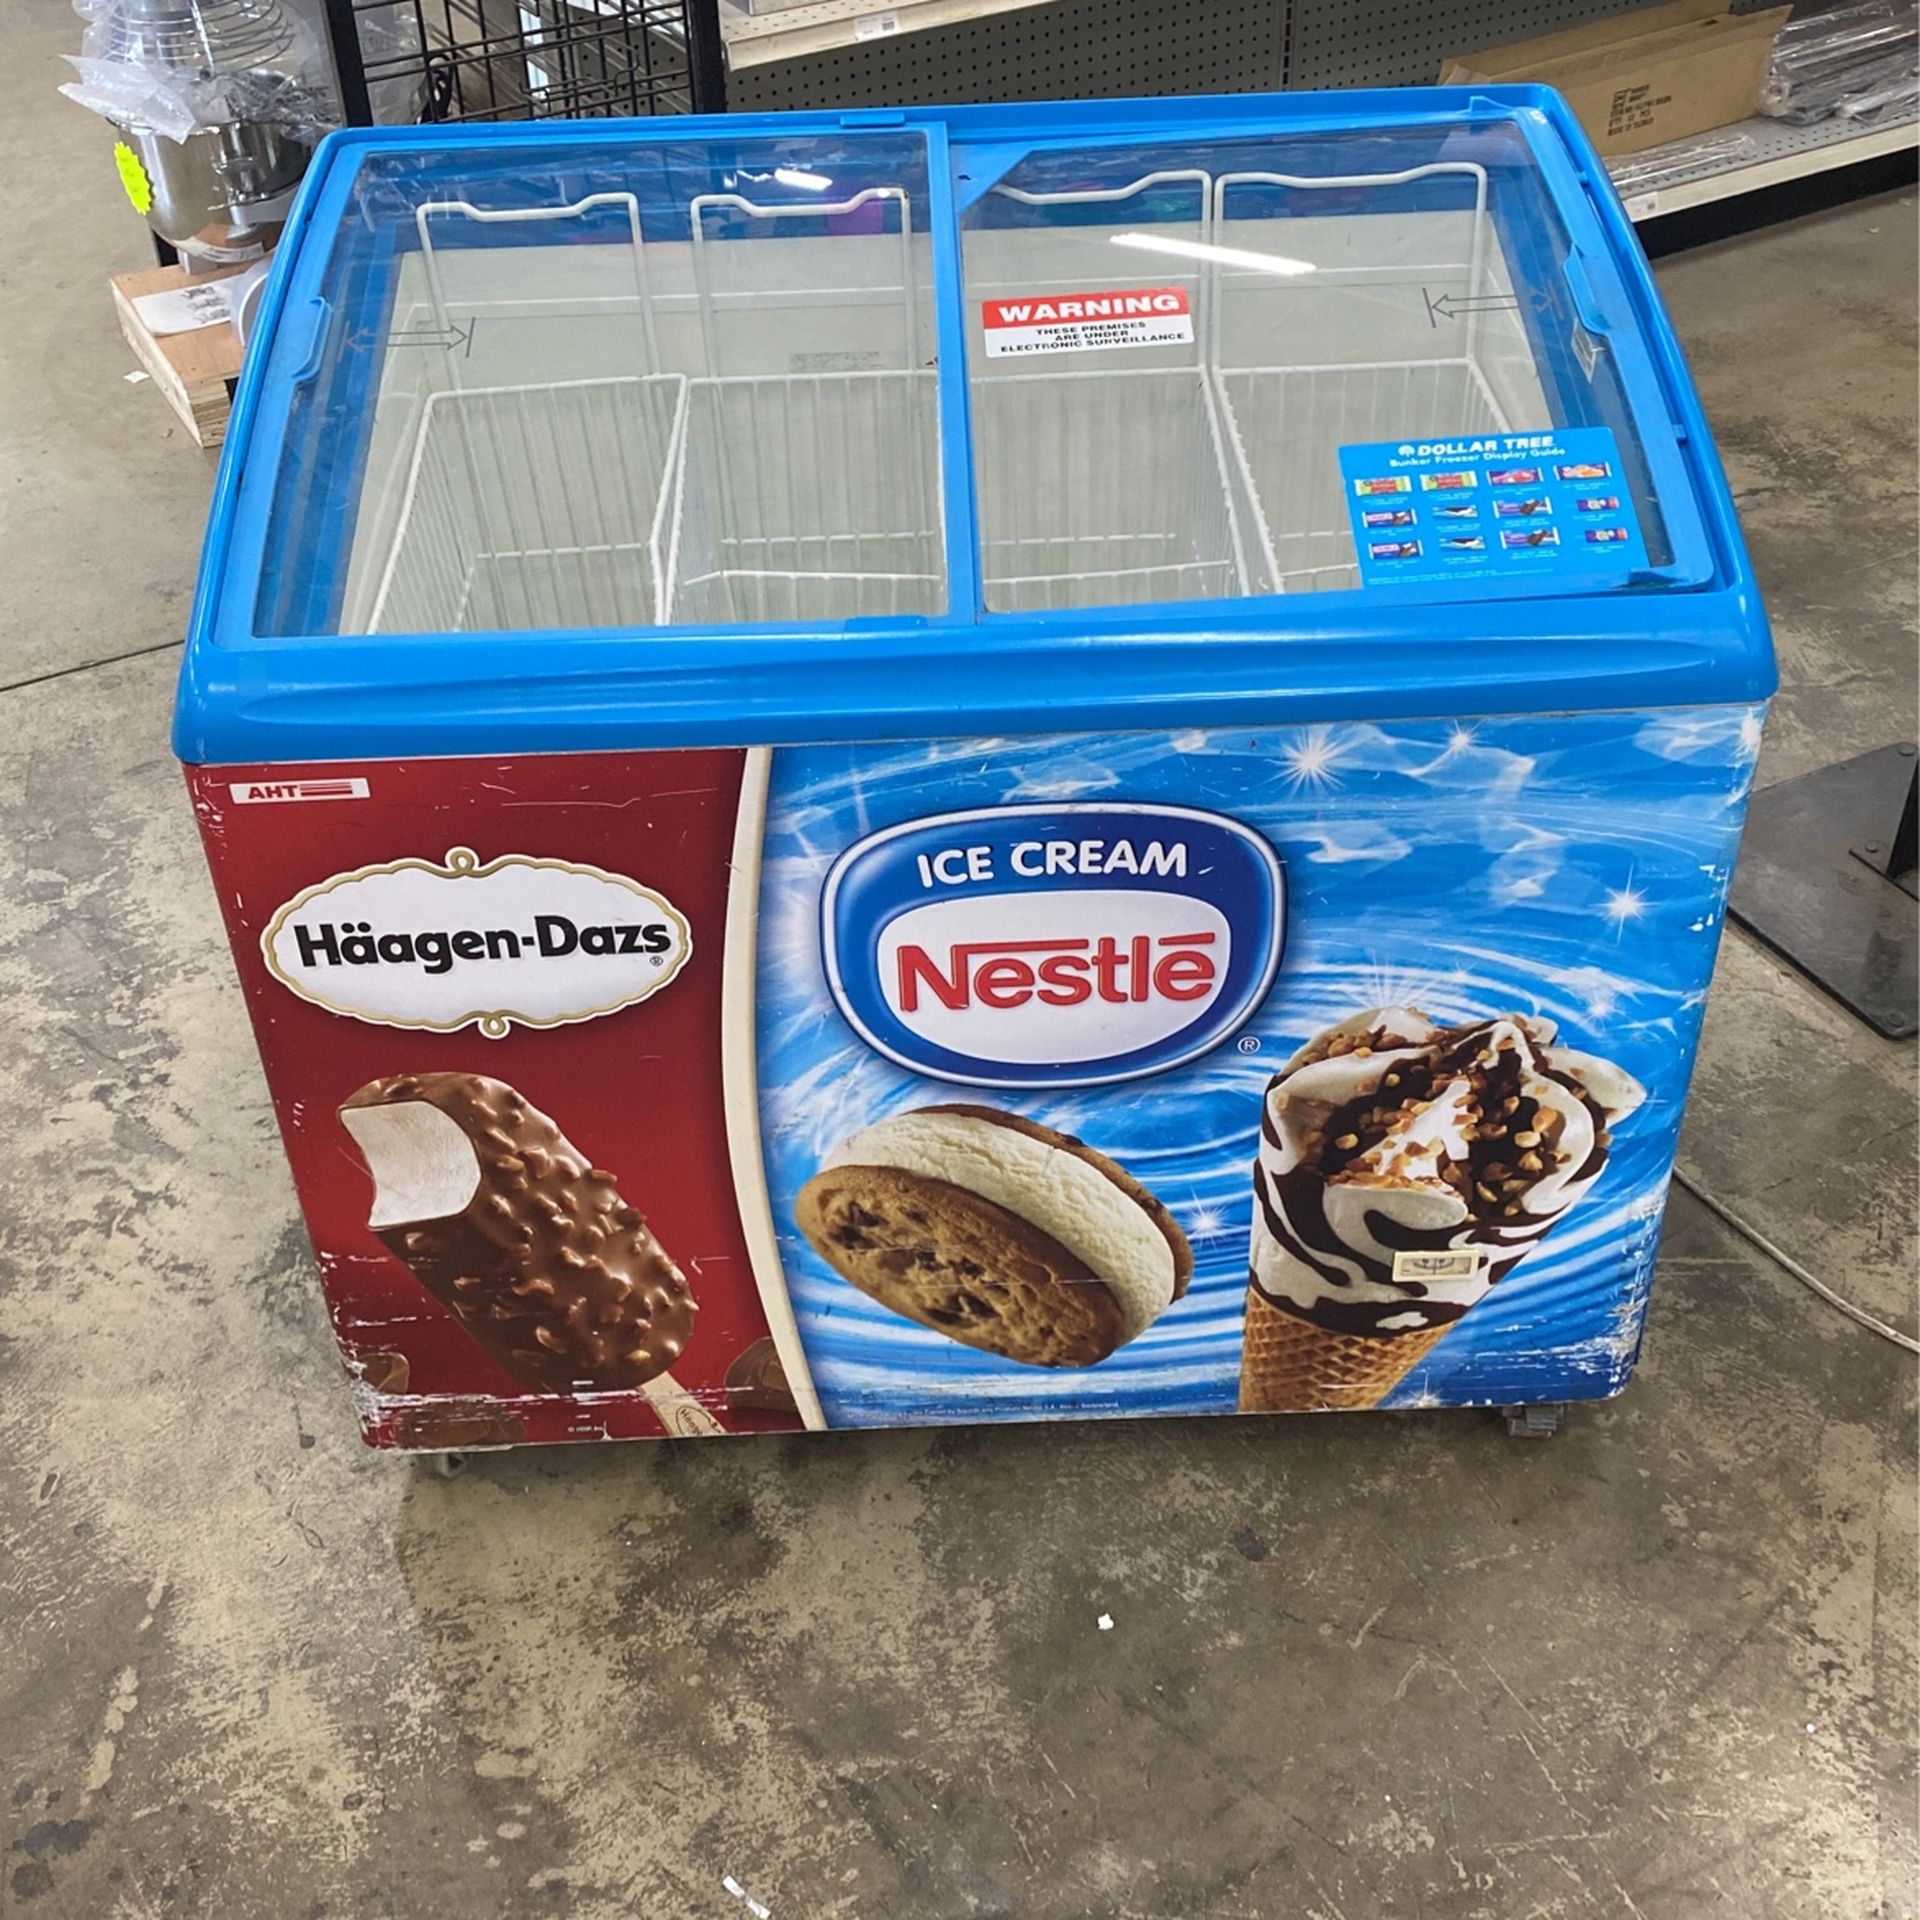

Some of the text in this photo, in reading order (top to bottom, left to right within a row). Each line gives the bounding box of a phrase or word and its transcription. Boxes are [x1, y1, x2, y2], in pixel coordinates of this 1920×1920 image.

[998, 295, 1180, 322] WARNING
[1036, 322, 1146, 336] THESE PREMISES
[1055, 331, 1129, 341] ARE UNDER
[1001, 332, 1185, 352] ELECTRONIC SURVEILLANCE
[1417, 436, 1555, 456] DOLLAR TREE
[1389, 447, 1566, 467] Bunker Freezer Display Guide
[247, 784, 299, 799] AHT
[916, 839, 1188, 888] ICE CREAM
[294, 914, 673, 975] Häagen-Dazs
[896, 931, 1217, 1012] Nestlé
